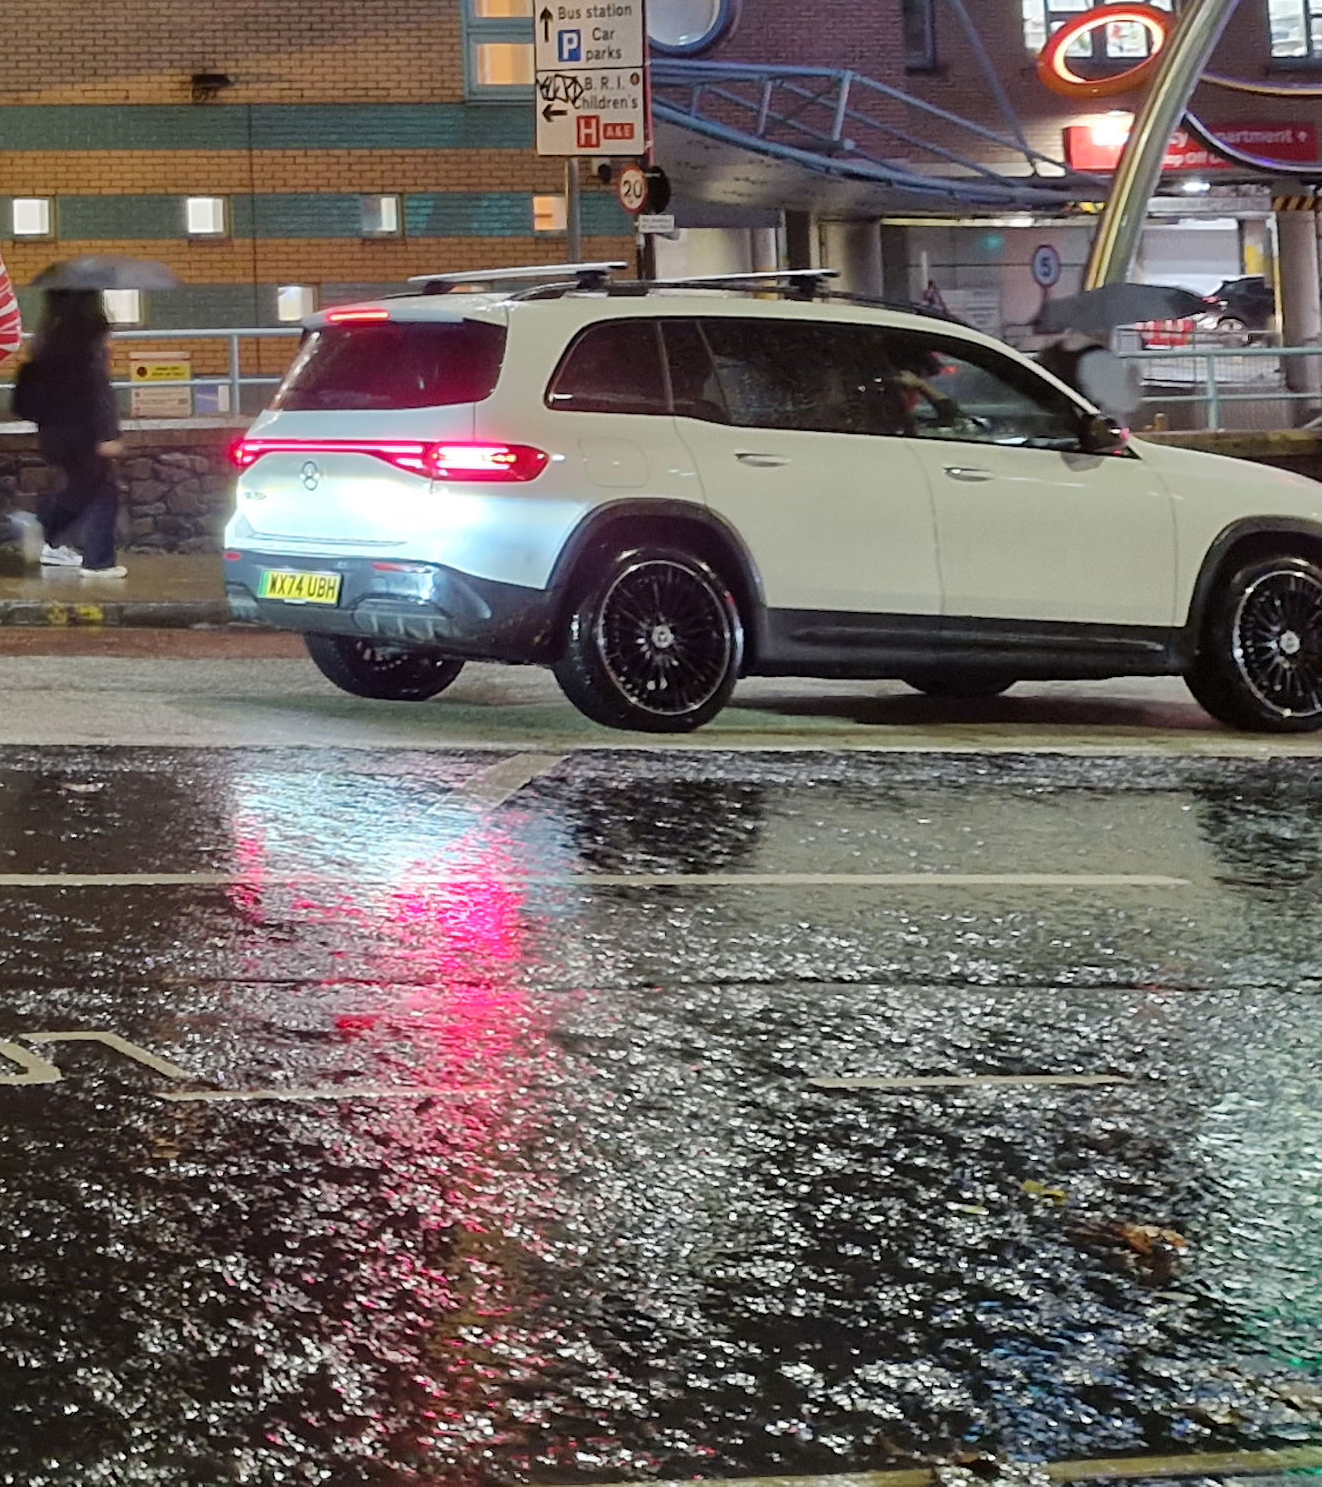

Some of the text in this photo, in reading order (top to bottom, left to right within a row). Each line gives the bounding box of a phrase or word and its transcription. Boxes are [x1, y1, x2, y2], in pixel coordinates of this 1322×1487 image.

[558, 3, 632, 20] Bus station
[592, 27, 616, 41] Car
[563, 32, 579, 60] P
[585, 46, 622, 63] parks
[578, 118, 597, 145] H
[622, 180, 643, 199] 20
[306, 576, 337, 599] UBH
